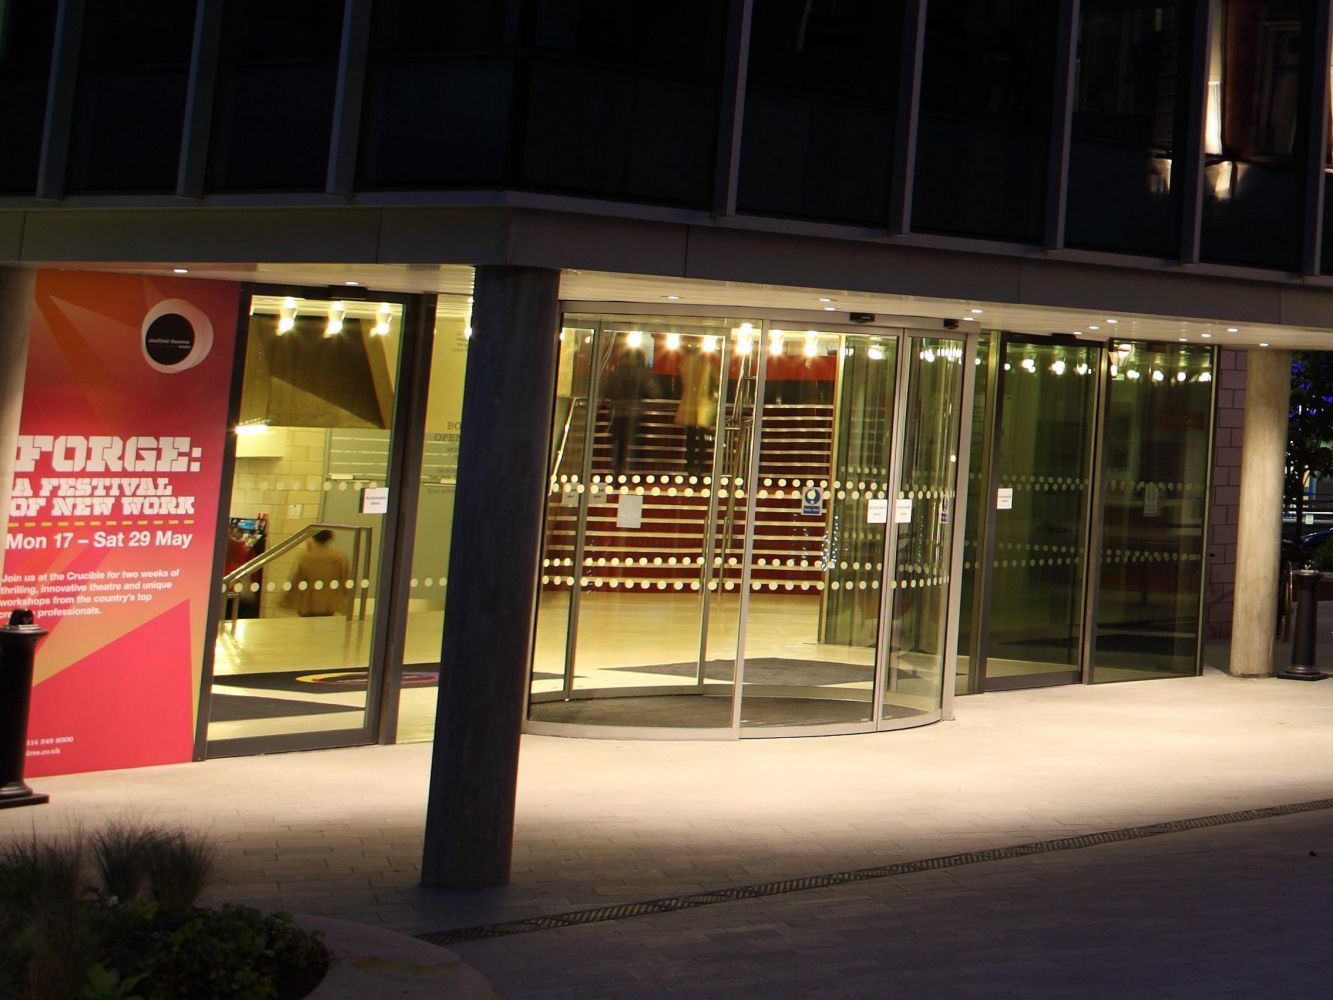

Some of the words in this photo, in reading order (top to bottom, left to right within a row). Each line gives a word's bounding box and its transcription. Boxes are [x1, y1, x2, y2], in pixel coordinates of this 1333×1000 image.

[15, 435, 202, 472] FORGE:
[12, 478, 33, 497] A
[39, 477, 173, 496] FESTIVAL
[9, 497, 47, 517] OF
[51, 497, 115, 516] NEW
[121, 496, 195, 515] WORK
[6, 533, 47, 549] Mon
[54, 533, 74, 548] 17
[93, 531, 124, 548] Sat
[128, 531, 151, 546] 29
[155, 531, 192, 549] May
[2, 574, 22, 582] Join
[49, 573, 65, 581] the
[66, 571, 105, 580] Crucible
[107, 570, 120, 579] for
[140, 569, 169, 578] weeks
[170, 569, 180, 577] of
[41, 583, 88, 593] innovative
[89, 582, 121, 591] theatre
[123, 581, 141, 590] and
[142, 581, 173, 591] unique
[0, 596, 51, 606] workshops
[53, 596, 75, 604] from
[77, 595, 91, 603] the
[137, 593, 152, 602] top
[37, 606, 102, 618] professionals.
